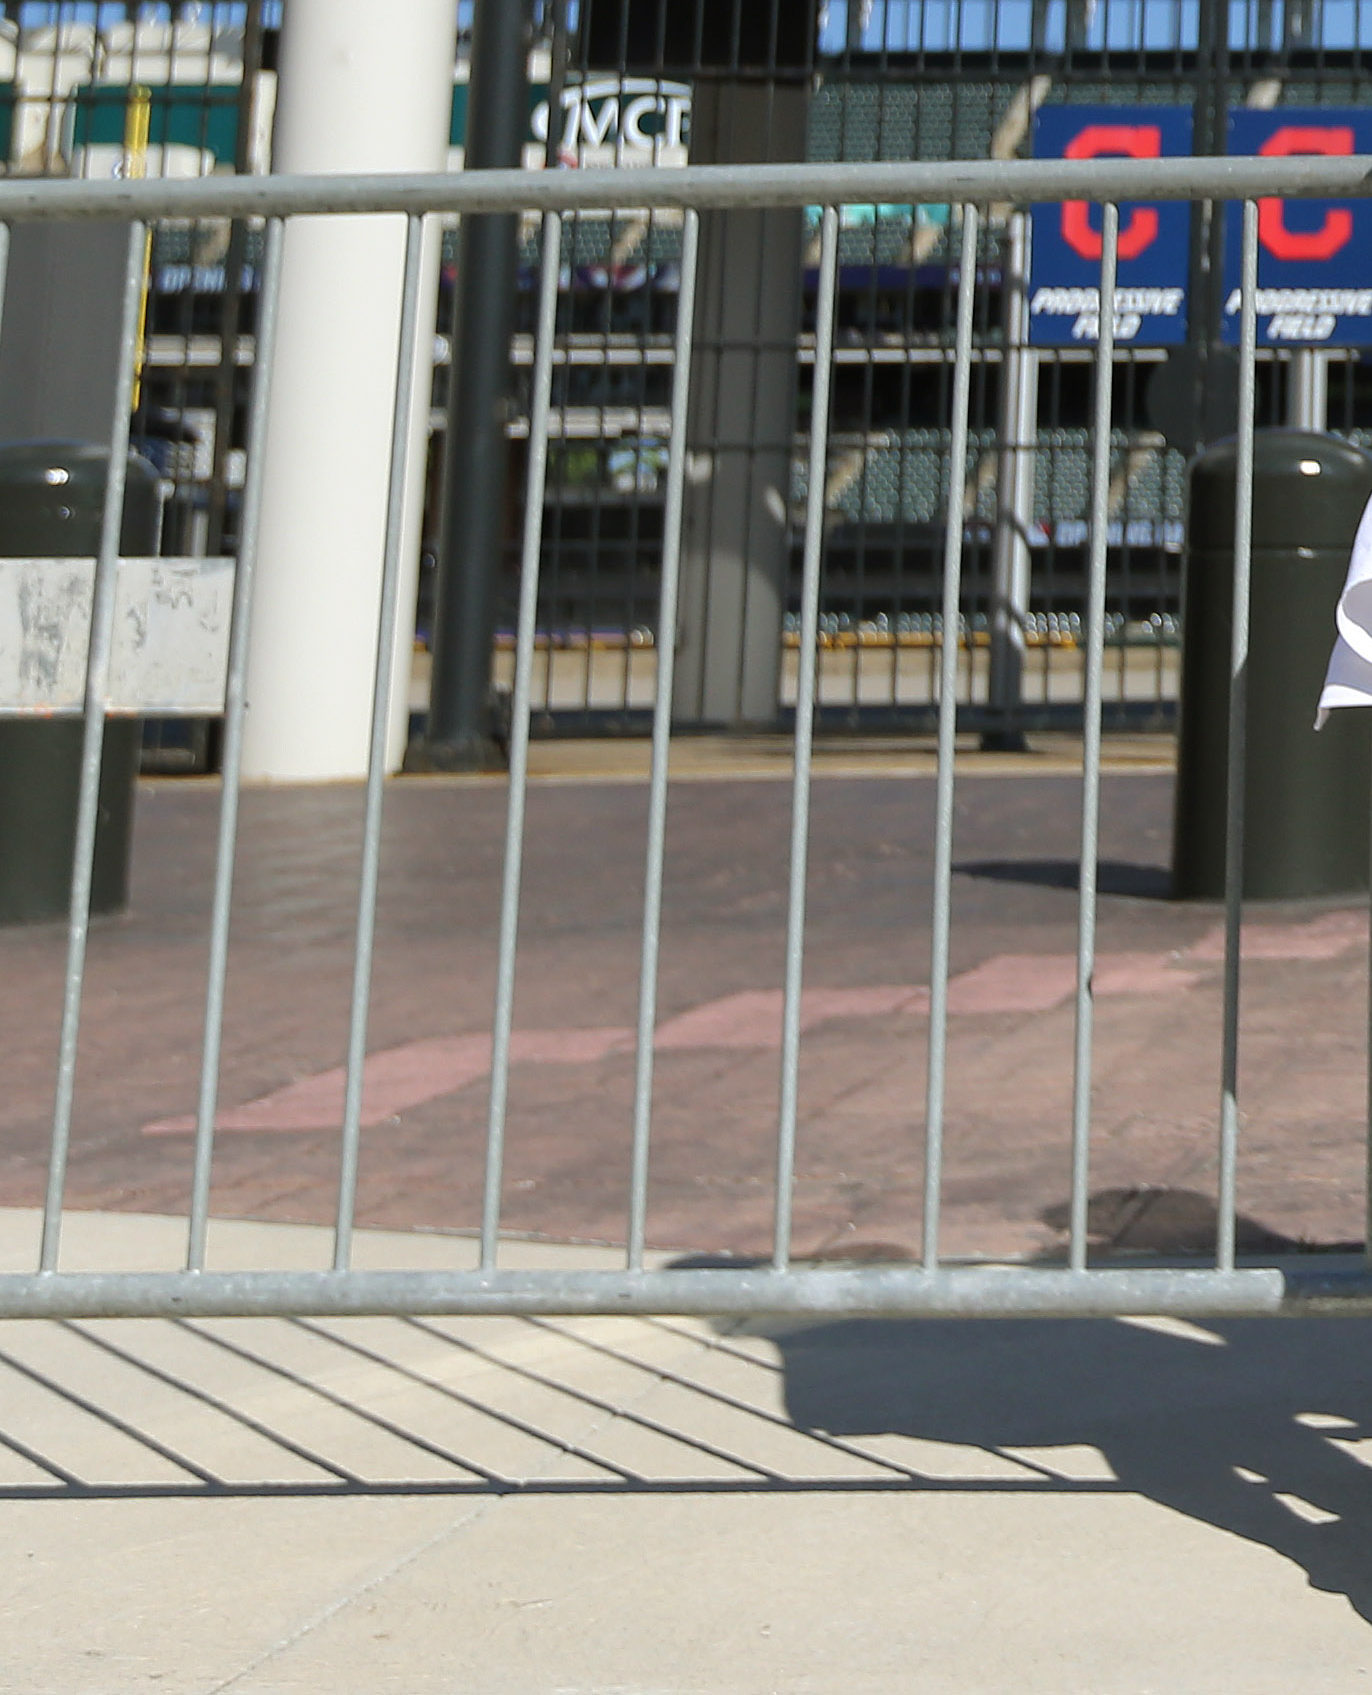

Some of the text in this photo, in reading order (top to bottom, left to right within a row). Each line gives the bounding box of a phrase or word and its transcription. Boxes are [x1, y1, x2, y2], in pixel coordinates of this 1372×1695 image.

[1030, 287, 1185, 316] PROGRSSIVE
[1071, 313, 1142, 340] FID
[1266, 314, 1337, 340] FIELD
